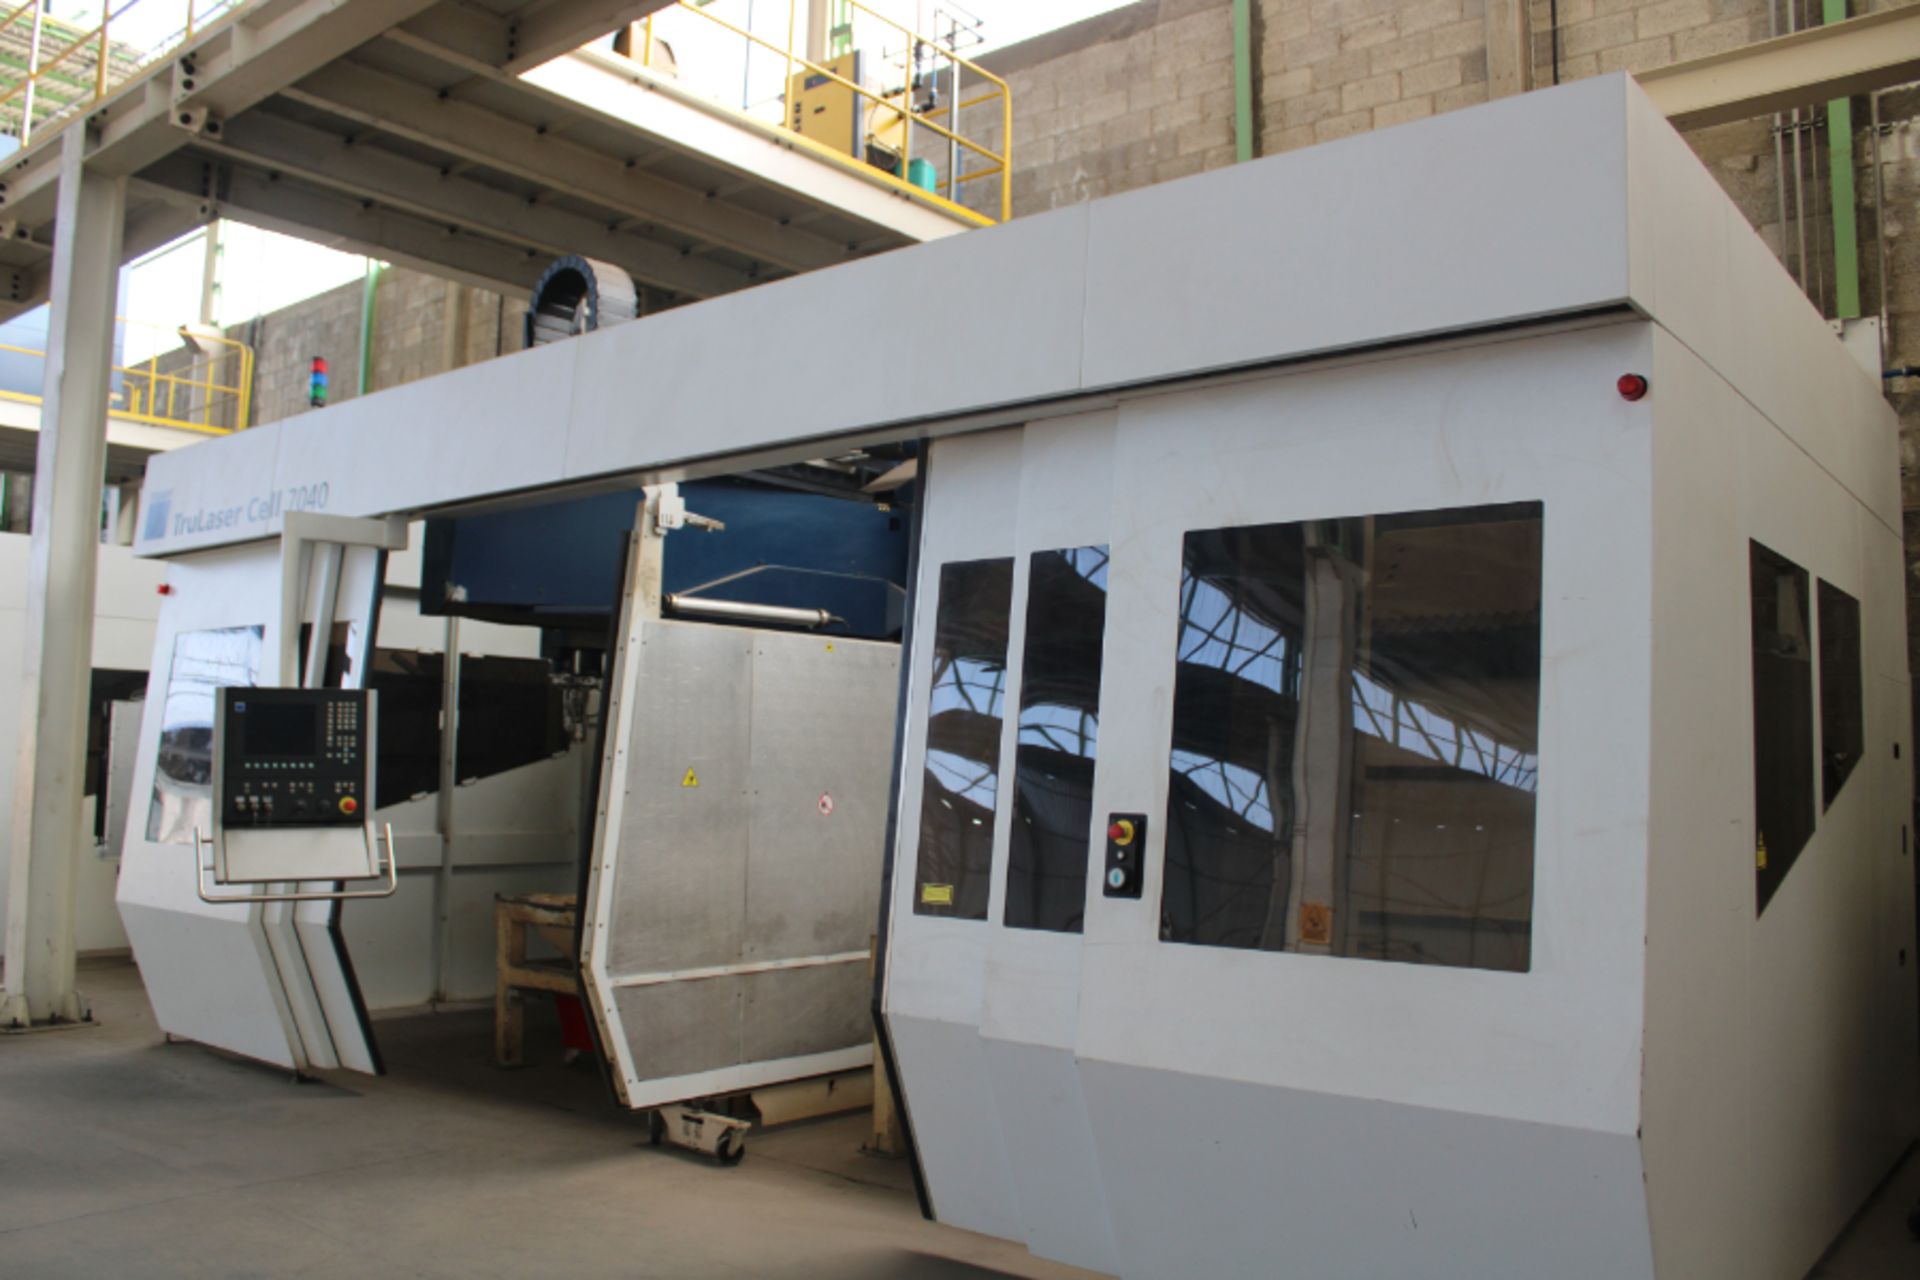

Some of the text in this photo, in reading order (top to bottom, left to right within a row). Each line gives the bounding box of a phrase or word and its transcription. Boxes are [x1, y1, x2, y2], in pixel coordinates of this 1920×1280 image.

[173, 481, 329, 536] TruLaser Cell 7040
